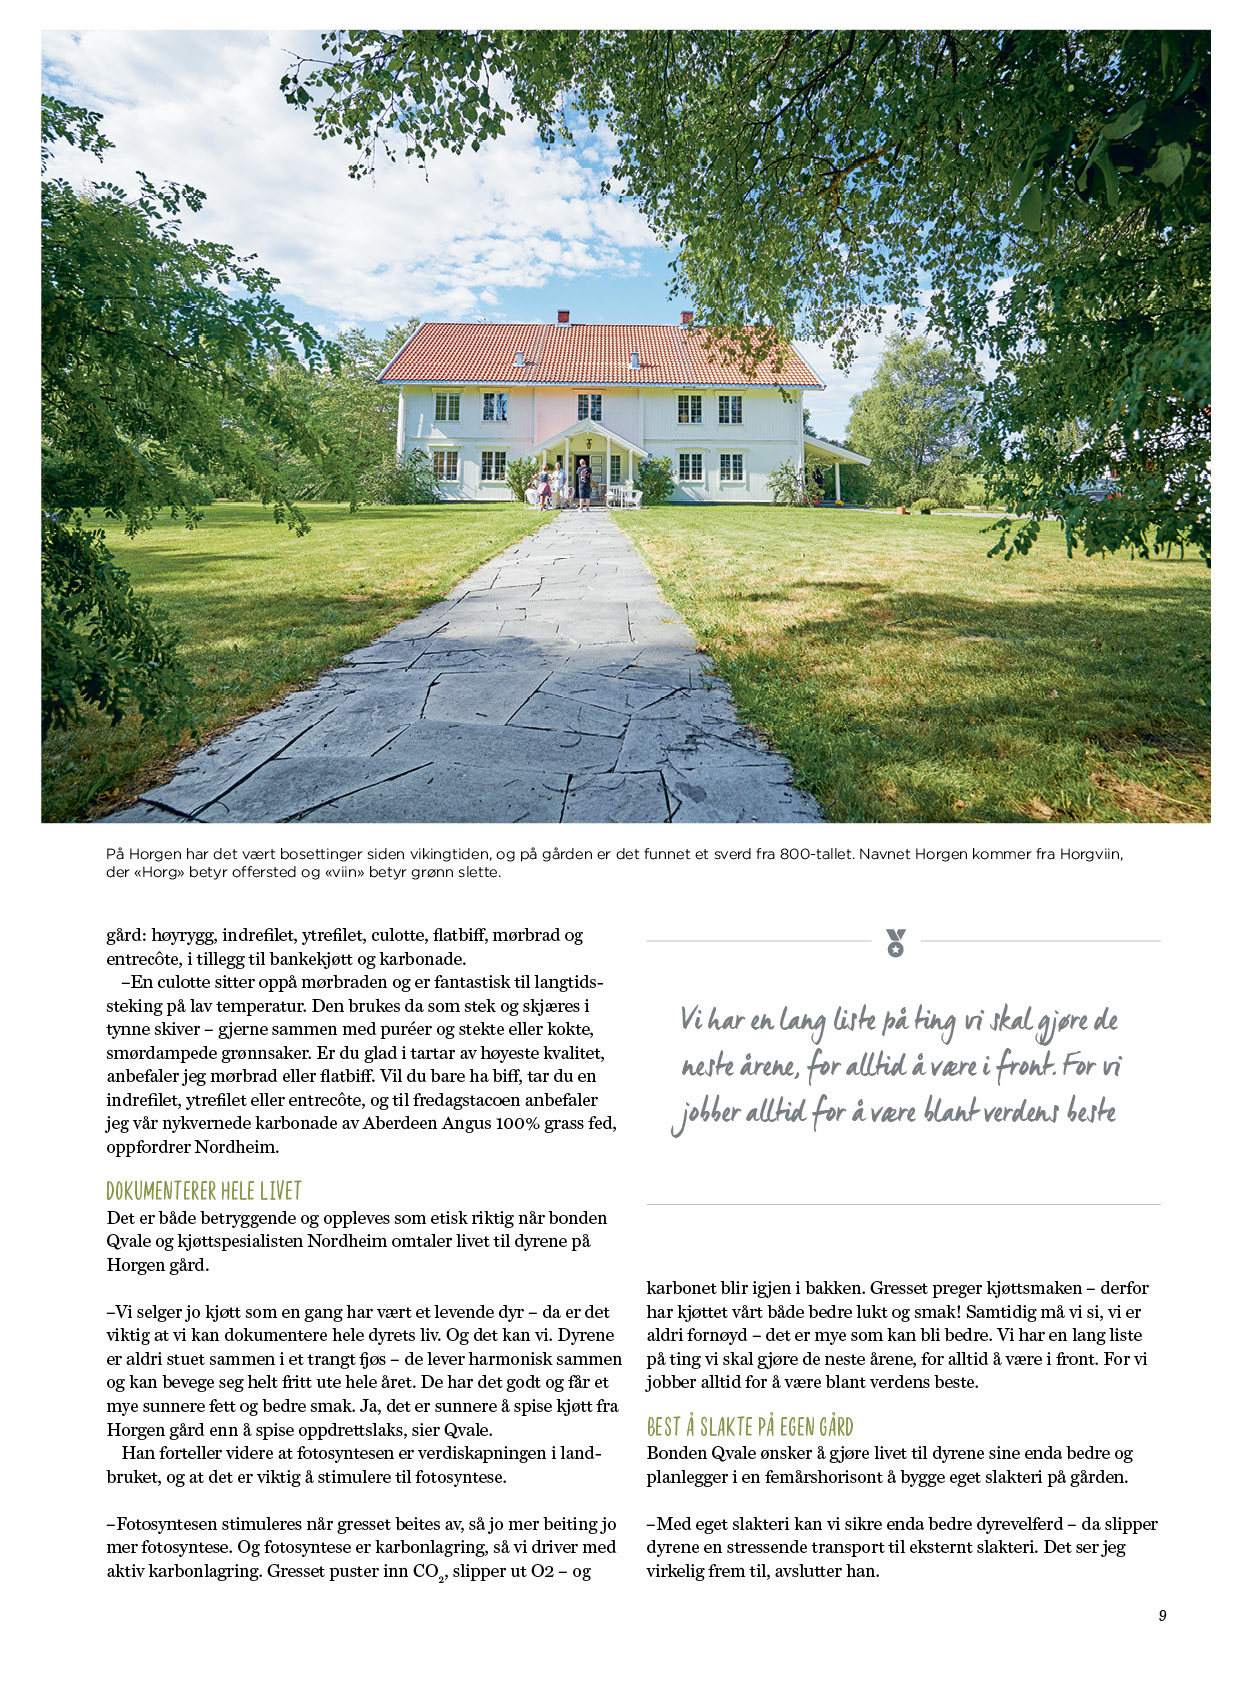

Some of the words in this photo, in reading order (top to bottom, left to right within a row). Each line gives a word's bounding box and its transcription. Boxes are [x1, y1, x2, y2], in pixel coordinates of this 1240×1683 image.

[106, 846, 125, 861] På
[129, 847, 182, 863] Horgen
[186, 847, 210, 861] har
[212, 847, 238, 861] det
[241, 848, 276, 861] vært
[280, 847, 364, 863] bosettinger
[367, 847, 405, 861] siden
[409, 847, 493, 863] vikingtiden,
[495, 850, 516, 863] og
[520, 846, 538, 863] på
[542, 846, 593, 863] gården
[596, 850, 612, 861] er
[615, 847, 640, 861] det
[643, 847, 691, 861] funnet
[694, 848, 709, 861] et
[714, 847, 752, 861] sverd
[755, 847, 776, 861] fra
[859, 847, 911, 861] Navnet
[915, 847, 968, 863] Horgen
[972, 847, 1033, 861] kommer
[1035, 847, 1056, 861] fra
[1060, 847, 1124, 863] Horgviin,
[106, 865, 131, 879] der
[189, 865, 229, 881] betyr
[231, 865, 297, 879] offersted
[300, 868, 321, 881] og
[369, 865, 408, 881] betyr
[410, 868, 454, 881] grønn
[458, 865, 502, 879] slette.
[105, 927, 147, 946] gård:
[150, 927, 218, 946] høyrygg,
[221, 927, 298, 945] indrefilet,
[301, 927, 367, 946] ytrefilet,
[371, 927, 429, 945] culotte,
[432, 927, 489, 945] flatbiff,
[492, 927, 561, 942] mørbrad
[564, 931, 584, 946] og
[106, 998, 164, 1017] steking
[166, 998, 187, 1017] på
[189, 998, 214, 1013] lav
[215, 1000, 307, 1017] temperatur.
[311, 998, 345, 1013] Den
[347, 998, 401, 1013] brukes
[404, 998, 425, 1013] da
[427, 1002, 461, 1013] som
[464, 998, 497, 1013] stek
[500, 1002, 520, 1017] og
[522, 998, 581, 1017] skjæres
[583, 998, 590, 1013] i
[681, 1004, 703, 1030] Vi
[707, 1006, 746, 1031] har
[750, 1013, 775, 1031] en
[779, 1005, 827, 1046] lang
[833, 1003, 876, 1032] liste
[881, 1006, 910, 1037] på
[914, 1003, 957, 1046] ting
[965, 1009, 985, 1031] vi
[989, 1002, 1034, 1032] skal
[1034, 1009, 1088, 1047] gjøre
[1093, 1006, 1118, 1031] de
[681, 1049, 734, 1078] neste
[739, 1052, 800, 1080] årene,
[806, 1047, 842, 1087] for
[845, 1049, 908, 1077] alltid
[911, 1052, 927, 1076] å
[930, 1060, 977, 1077] være
[982, 1055, 991, 1076] i
[995, 1047, 1057, 1087] front.
[1062, 1050, 1097, 1076] For
[1103, 1055, 1123, 1077] vi
[104, 1115, 130, 1134] jeg
[132, 1115, 159, 1130] vår
[162, 1115, 252, 1134] nykvernede
[254, 1115, 338, 1130] karbonade
[341, 1119, 361, 1130] av
[361, 1115, 438, 1130] Aberdeen
[440, 1116, 492, 1134] Angus
[495, 1116, 541, 1131] 100%
[543, 1119, 585, 1134] grass
[587, 1115, 617, 1133] fed,
[670, 1094, 742, 1139] jobber
[745, 1095, 808, 1123] alltid
[811, 1093, 847, 1133] for
[851, 1098, 867, 1122] å
[870, 1106, 916, 1123] være
[923, 1094, 982, 1123] blant
[983, 1098, 1060, 1124] verdens
[1066, 1094, 1116, 1124] beste
[106, 1179, 217, 1201] DOKUMENTERER
[221, 1180, 255, 1201] HELE
[260, 1179, 303, 1201] LIVET
[106, 1233, 152, 1251] Qvale
[155, 1237, 175, 1252] og
[176, 1233, 304, 1252] kjøttspesialisten
[306, 1233, 388, 1248] Nordheim
[391, 1233, 453, 1248] omtaler
[455, 1233, 491, 1248] livet
[492, 1233, 511, 1248] til
[514, 1233, 568, 1252] dyrene
[571, 1233, 592, 1252] på
[644, 1374, 697, 1393] jobber
[700, 1374, 742, 1389] alltid
[744, 1374, 768, 1389] for
[771, 1374, 782, 1389] å
[783, 1378, 822, 1389] være
[824, 1374, 867, 1389] blant
[869, 1374, 931, 1389] verdens
[933, 1374, 979, 1389] beste.
[106, 1422, 166, 1441] Horgen
[168, 1422, 206, 1441] gård
[209, 1425, 239, 1437] enn
[242, 1422, 253, 1437] å
[255, 1422, 295, 1441] spise
[298, 1422, 408, 1441] oppdrettslaks,
[411, 1422, 441, 1437] sier
[443, 1422, 493, 1440] Qvale.
[647, 1415, 682, 1437] BEST
[686, 1411, 695, 1437] Å
[700, 1415, 753, 1437] SLAKTE
[758, 1411, 775, 1437] PÅ
[780, 1416, 815, 1437] EGEN
[819, 1411, 854, 1437] GÅRD
[646, 1469, 729, 1488] planlegger
[731, 1469, 738, 1484] i
[741, 1472, 761, 1484] en
[764, 1469, 884, 1484] femårshorisont
[886, 1469, 897, 1484] å
[899, 1469, 946, 1488] bygge
[949, 1471, 982, 1488] eget
[985, 1469, 1043, 1484] slakteri
[1046, 1469, 1067, 1488] på
[1069, 1469, 1129, 1488] gården.
[1158, 1609, 1168, 1622] 9
